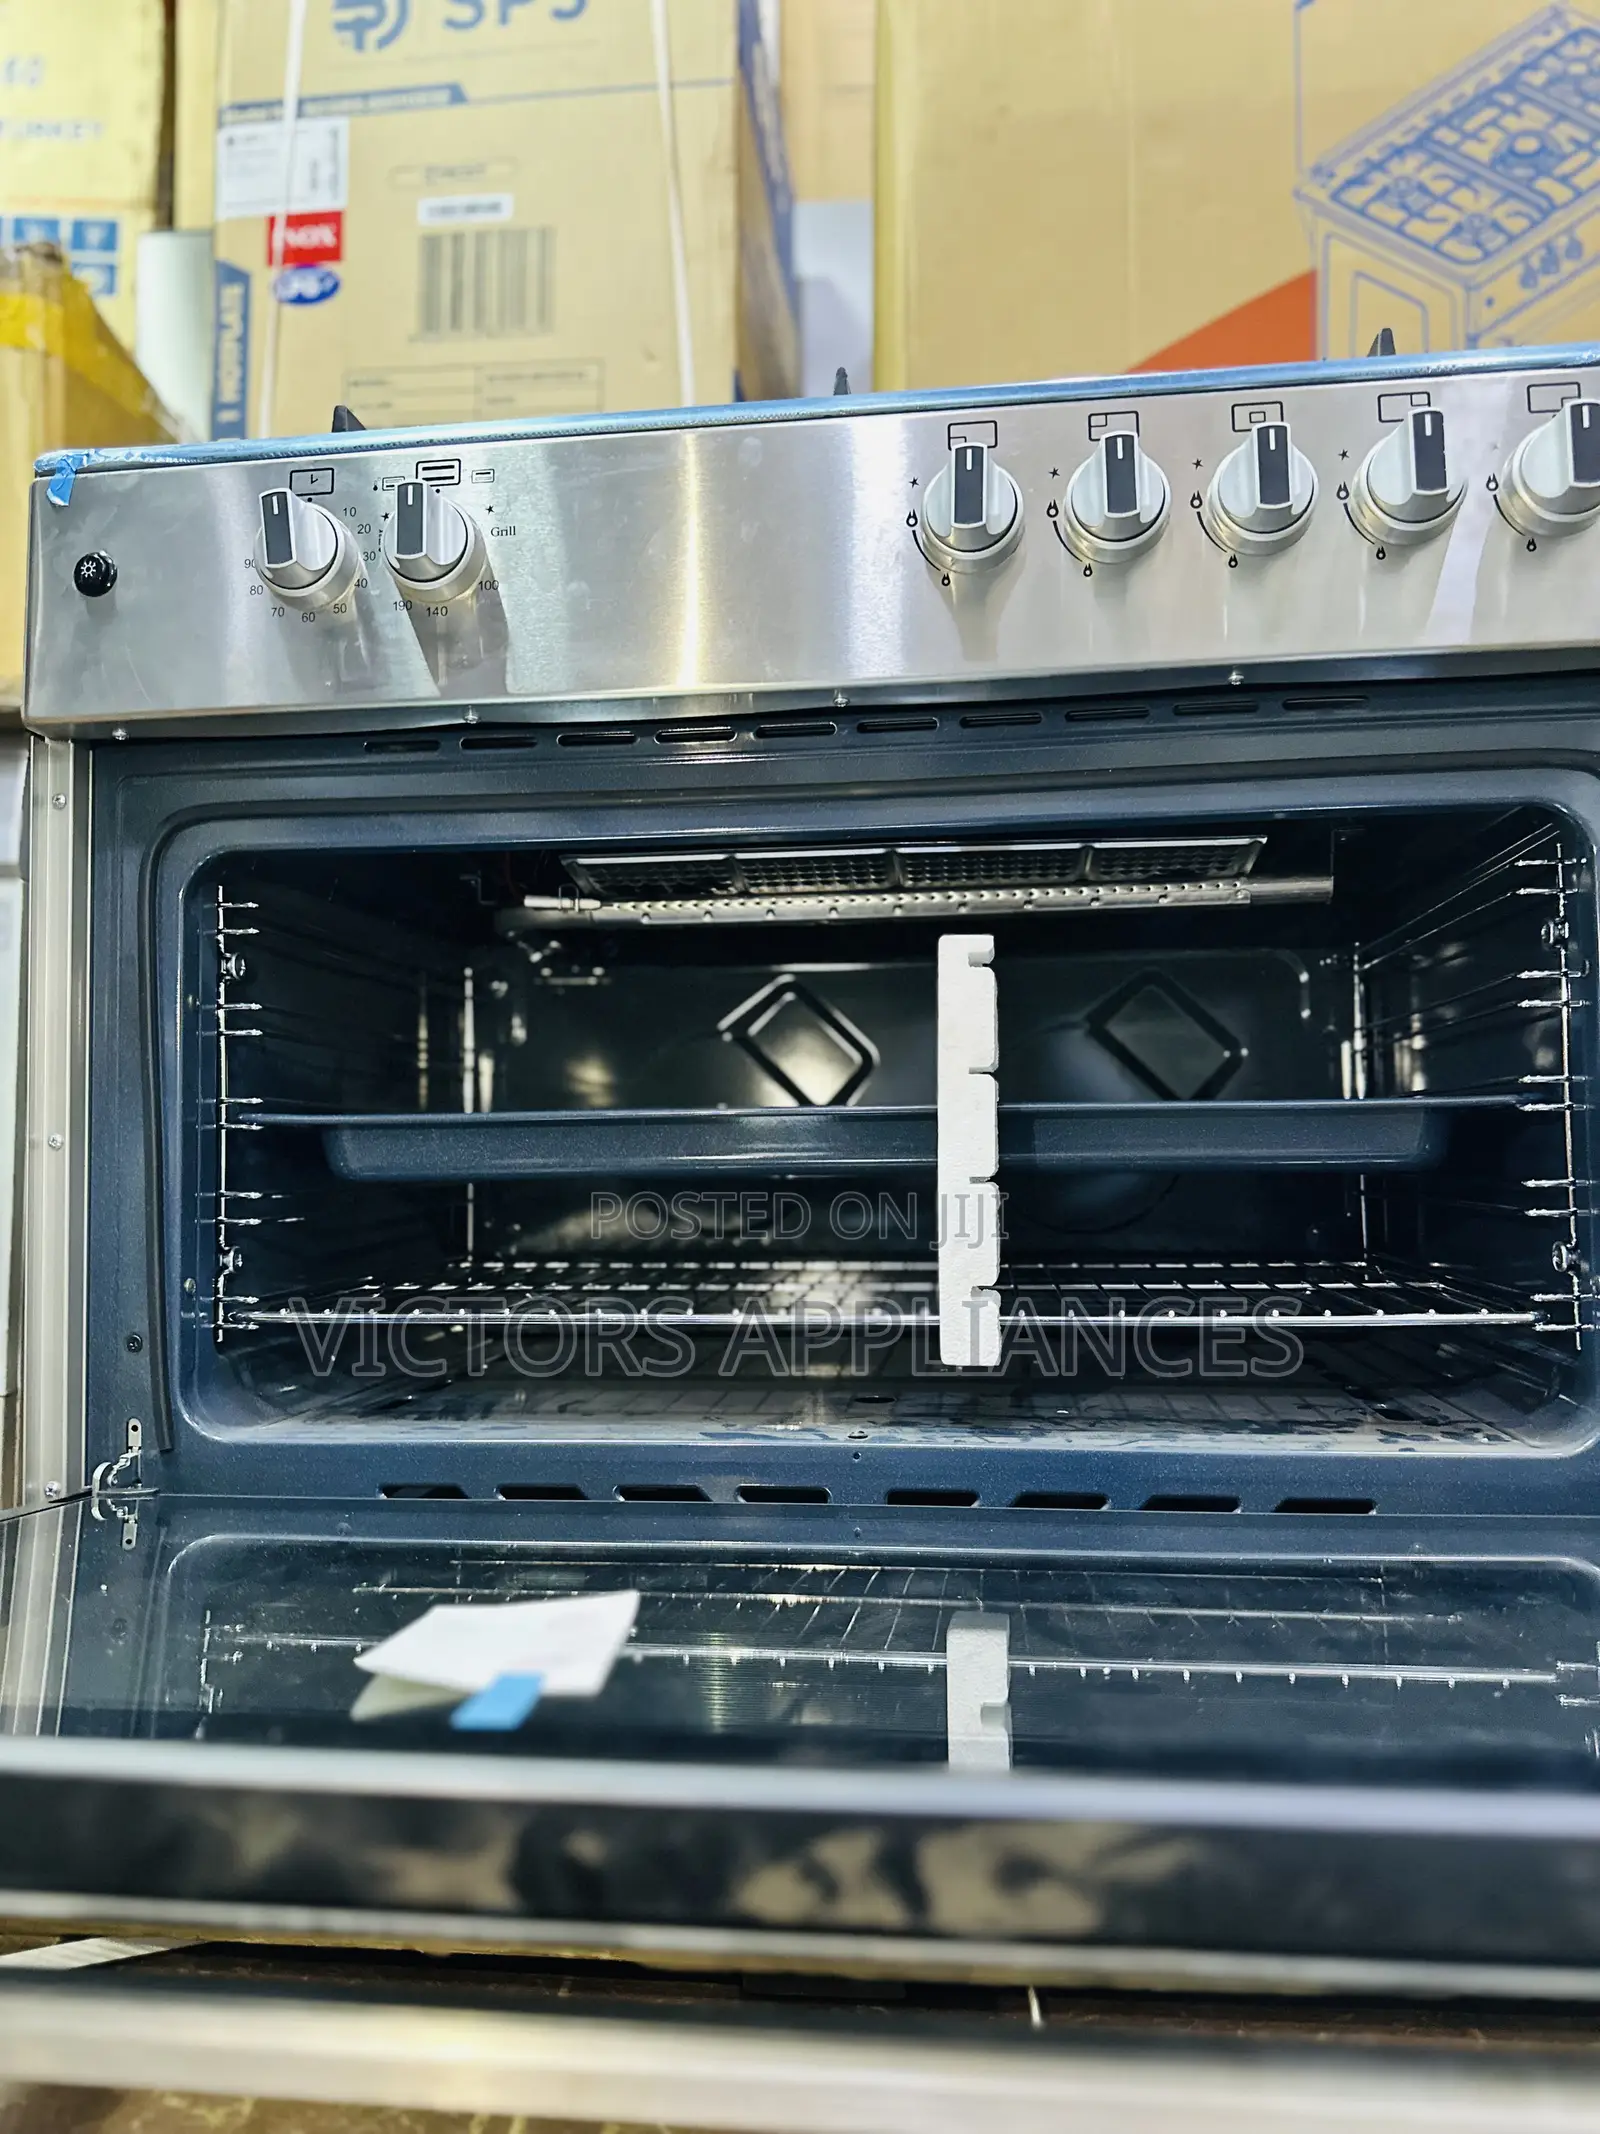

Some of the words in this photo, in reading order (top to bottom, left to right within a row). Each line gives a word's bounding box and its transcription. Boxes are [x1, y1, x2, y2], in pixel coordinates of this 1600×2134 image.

[343, 507, 356, 518] 10
[357, 524, 371, 535] 20
[490, 526, 516, 538] Grill
[363, 551, 376, 562] 30
[250, 584, 264, 596] 80
[354, 578, 368, 590] 40
[478, 580, 499, 592] 100
[271, 606, 285, 618] 70
[333, 603, 347, 615] 50
[393, 600, 413, 612] 190
[426, 606, 448, 618] 140
[301, 611, 316, 623] 60
